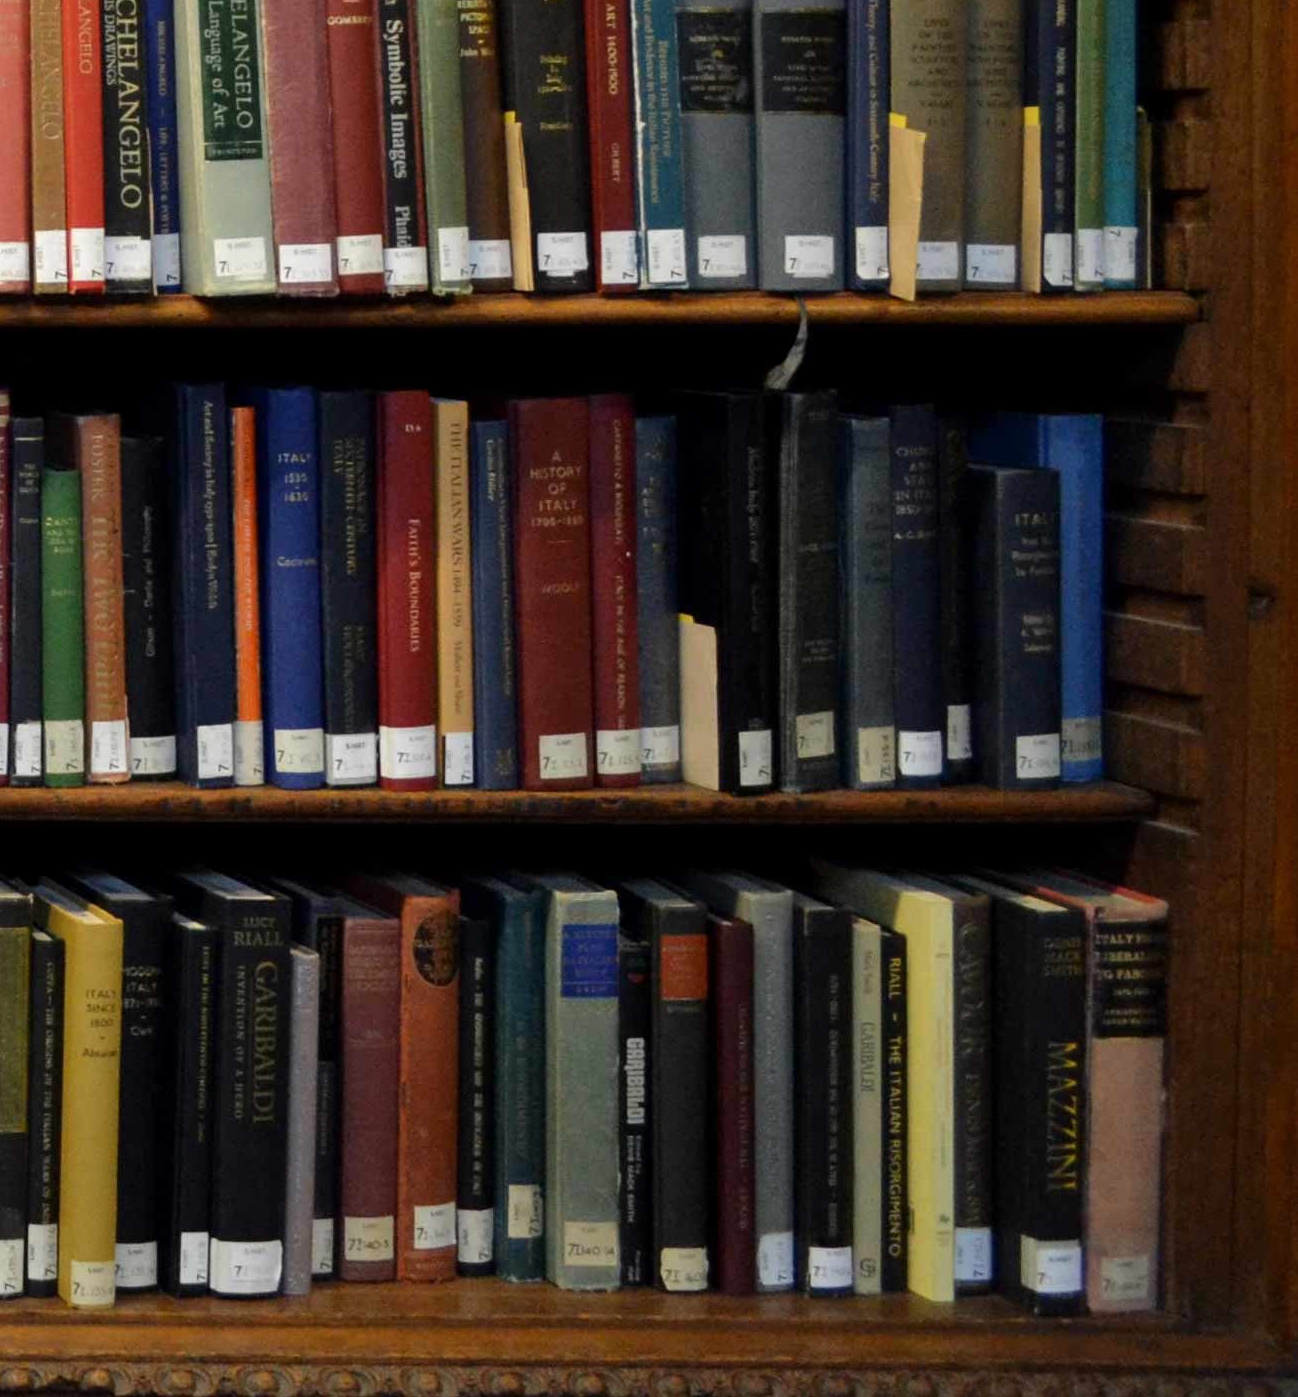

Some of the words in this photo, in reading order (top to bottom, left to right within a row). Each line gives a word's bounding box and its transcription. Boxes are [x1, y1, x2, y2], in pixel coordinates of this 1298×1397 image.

[206, 1, 223, 75] Language
[385, 19, 405, 105] Symbolic
[212, 77, 229, 94] of
[214, 99, 225, 129] Art
[389, 112, 406, 179] Images
[549, 483, 566, 493] OF
[889, 958, 901, 1000] RIALL
[253, 960, 277, 1124] GARIBALDI
[889, 1036, 902, 1065] THE
[889, 1069, 903, 1132] ITALIAN
[887, 1139, 903, 1256] RISORGIMENTO
